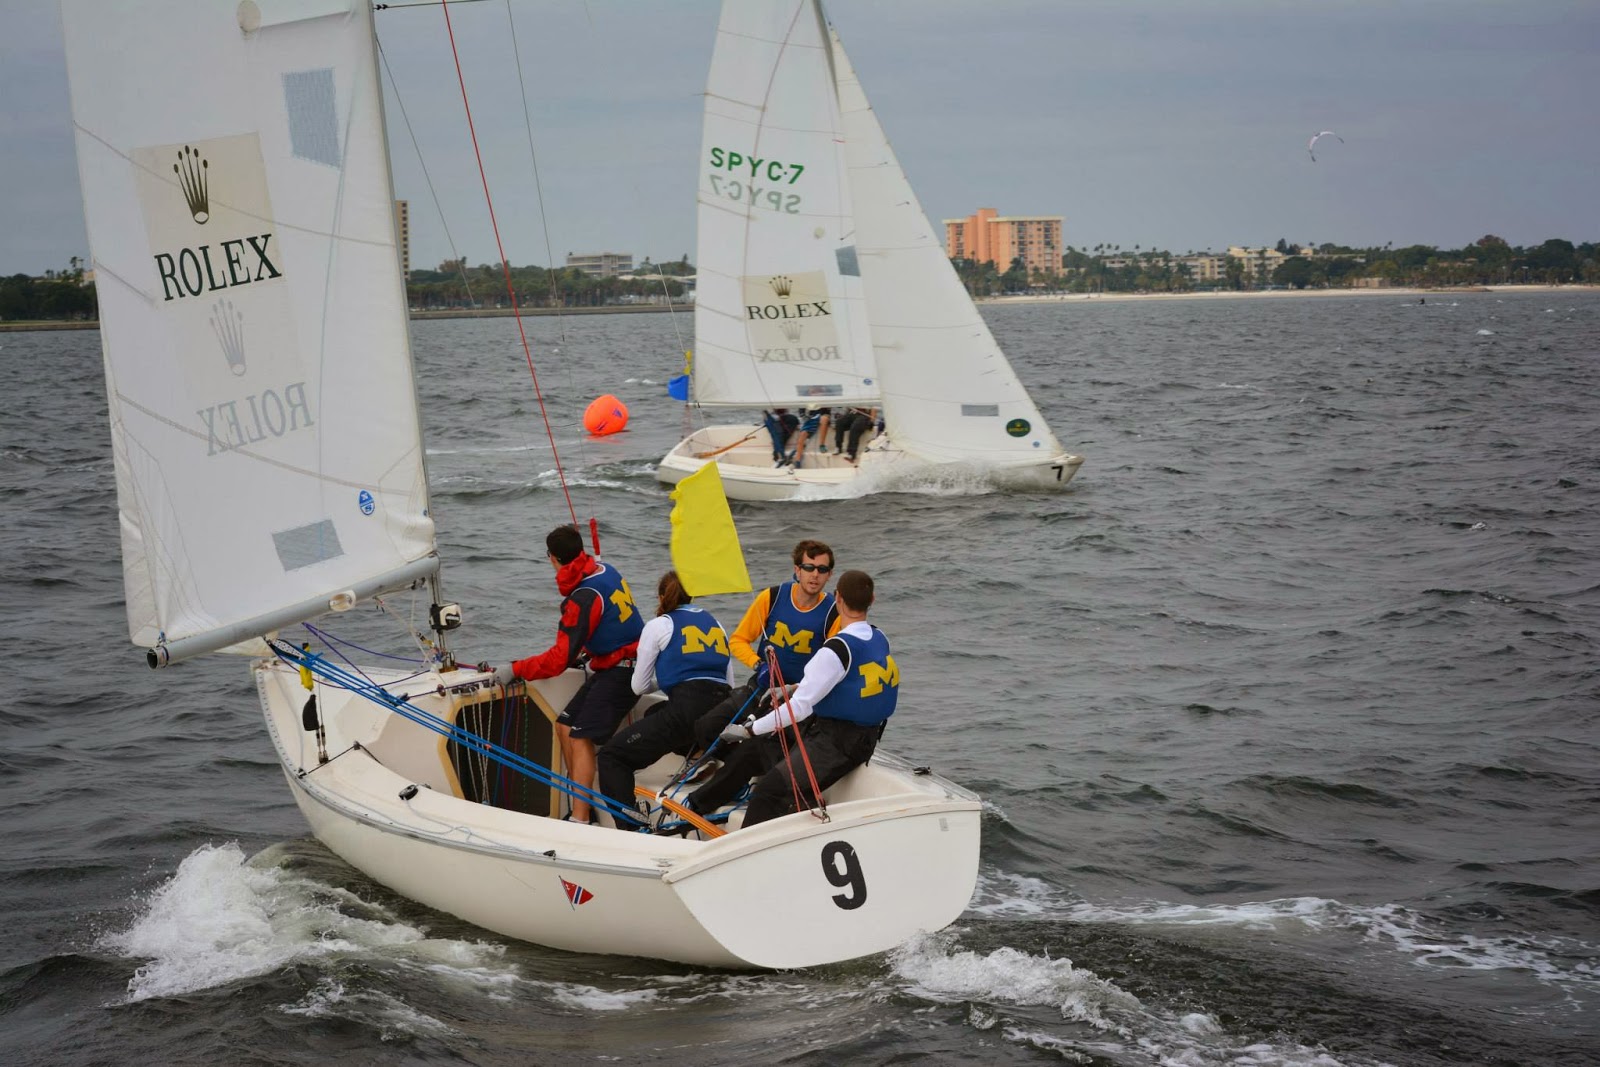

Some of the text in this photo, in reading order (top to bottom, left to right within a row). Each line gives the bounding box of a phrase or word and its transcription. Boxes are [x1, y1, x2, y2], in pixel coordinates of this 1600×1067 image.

[154, 233, 282, 301] ROLEX
[746, 301, 831, 321] ROLEX
[1051, 465, 1064, 481] 7
[609, 578, 634, 623] M
[681, 625, 730, 657] M
[769, 621, 814, 654] M
[858, 655, 900, 699] M
[820, 840, 867, 911] 9
